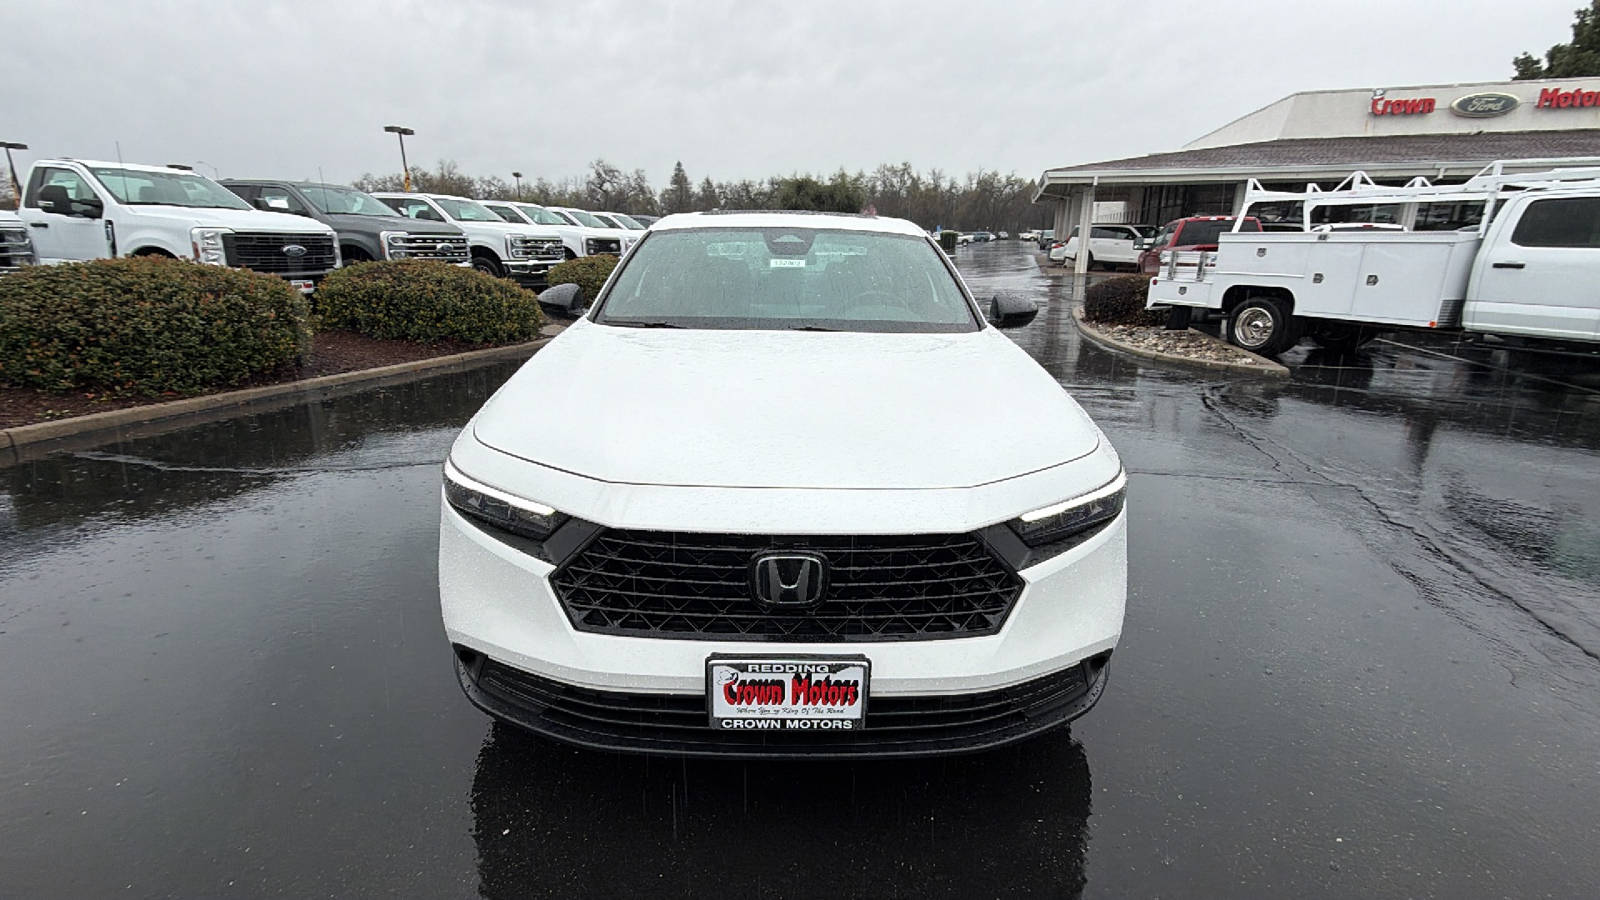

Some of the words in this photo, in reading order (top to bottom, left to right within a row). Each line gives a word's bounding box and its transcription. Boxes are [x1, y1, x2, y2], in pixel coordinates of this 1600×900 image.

[1371, 96, 1436, 116] Crown
[1467, 97, 1504, 112] Ford
[747, 664, 830, 673] REDDING
[723, 677, 785, 706] Crown
[791, 674, 859, 706] Motors
[781, 707, 799, 715] King
[721, 719, 781, 730] CROWN
[785, 719, 853, 730] MOTORS
